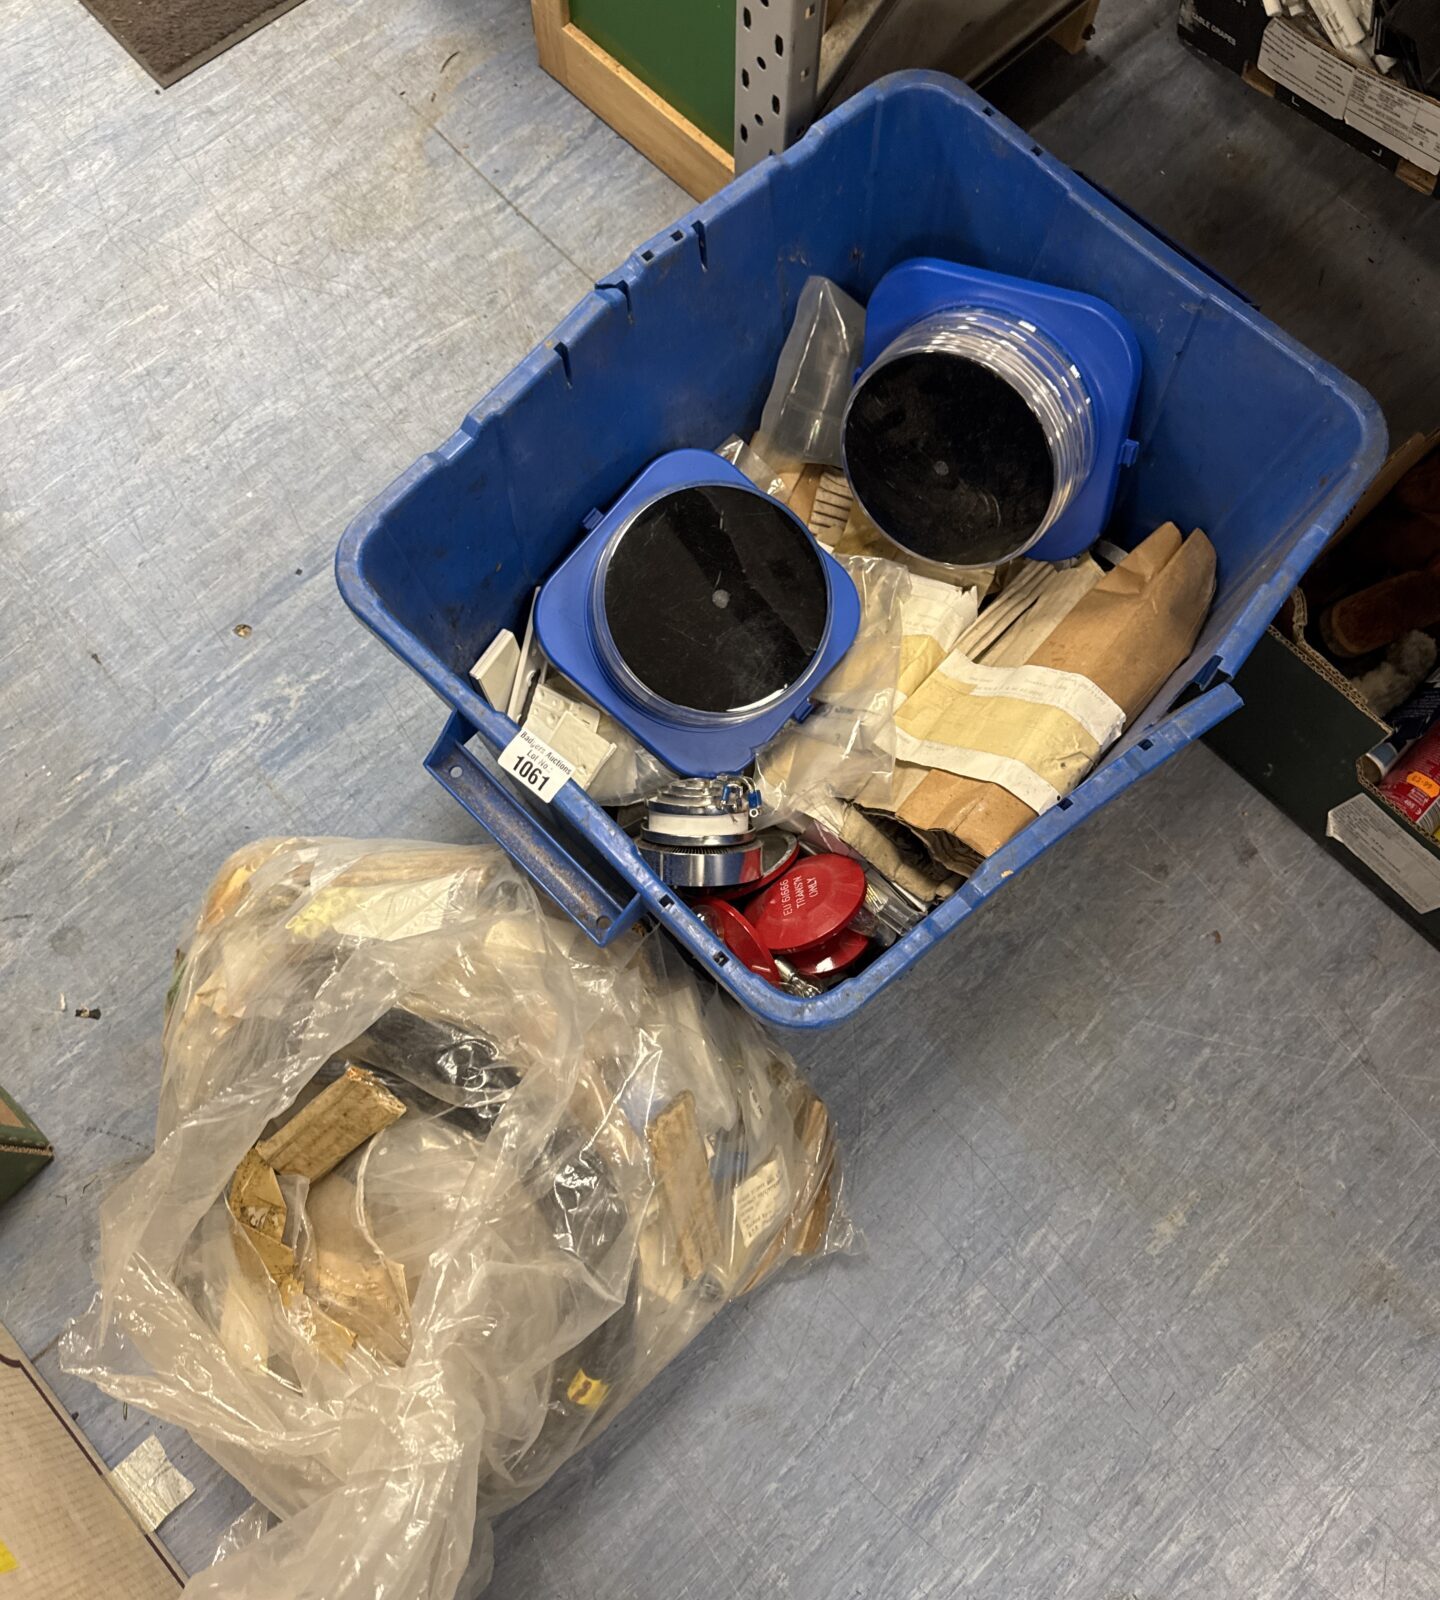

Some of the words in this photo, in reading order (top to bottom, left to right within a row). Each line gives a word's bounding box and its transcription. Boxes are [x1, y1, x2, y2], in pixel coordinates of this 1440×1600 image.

[526, 749, 540, 762] Lot
[546, 752, 572, 775] Auctions
[513, 756, 550, 791] 1061
[806, 877, 819, 898] ONLY
